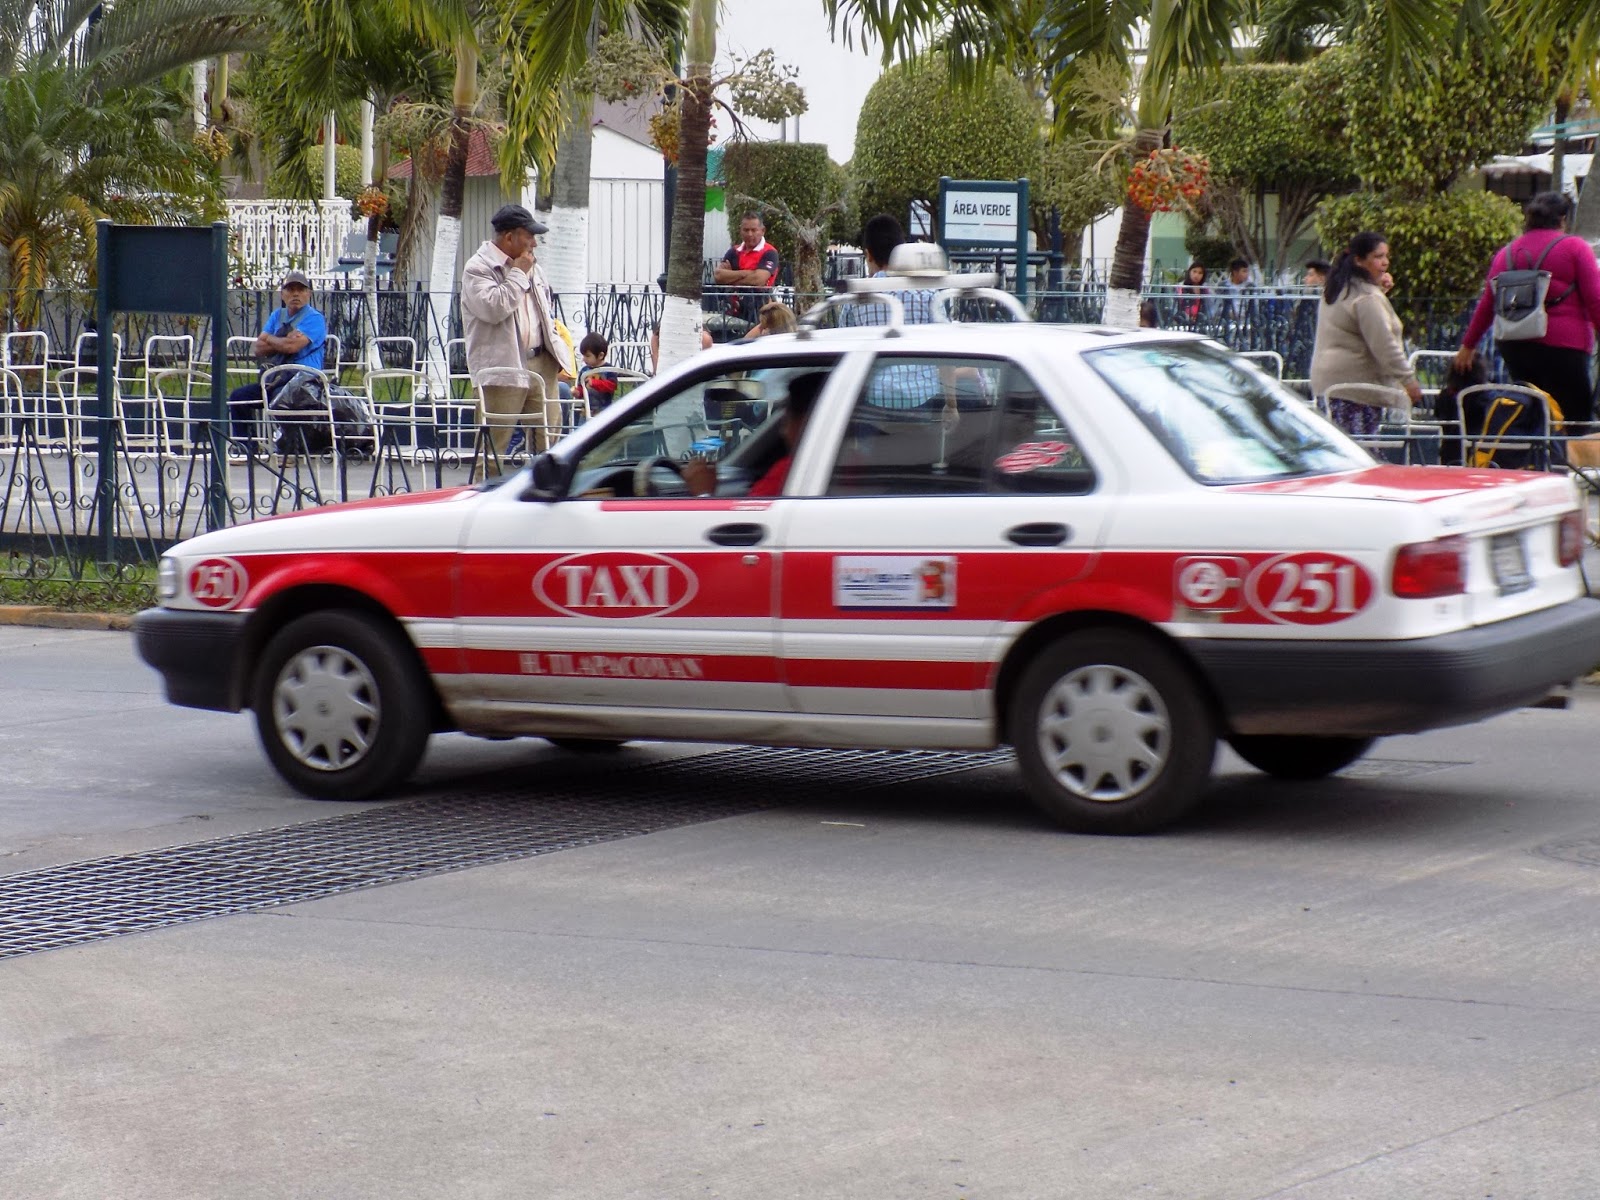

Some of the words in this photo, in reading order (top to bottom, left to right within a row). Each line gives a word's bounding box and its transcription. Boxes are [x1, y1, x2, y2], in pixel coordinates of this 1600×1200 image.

[953, 200, 978, 216] ÁREA
[980, 203, 1012, 217] VERDE
[556, 564, 672, 608] TAXI
[1267, 561, 1358, 614] 251
